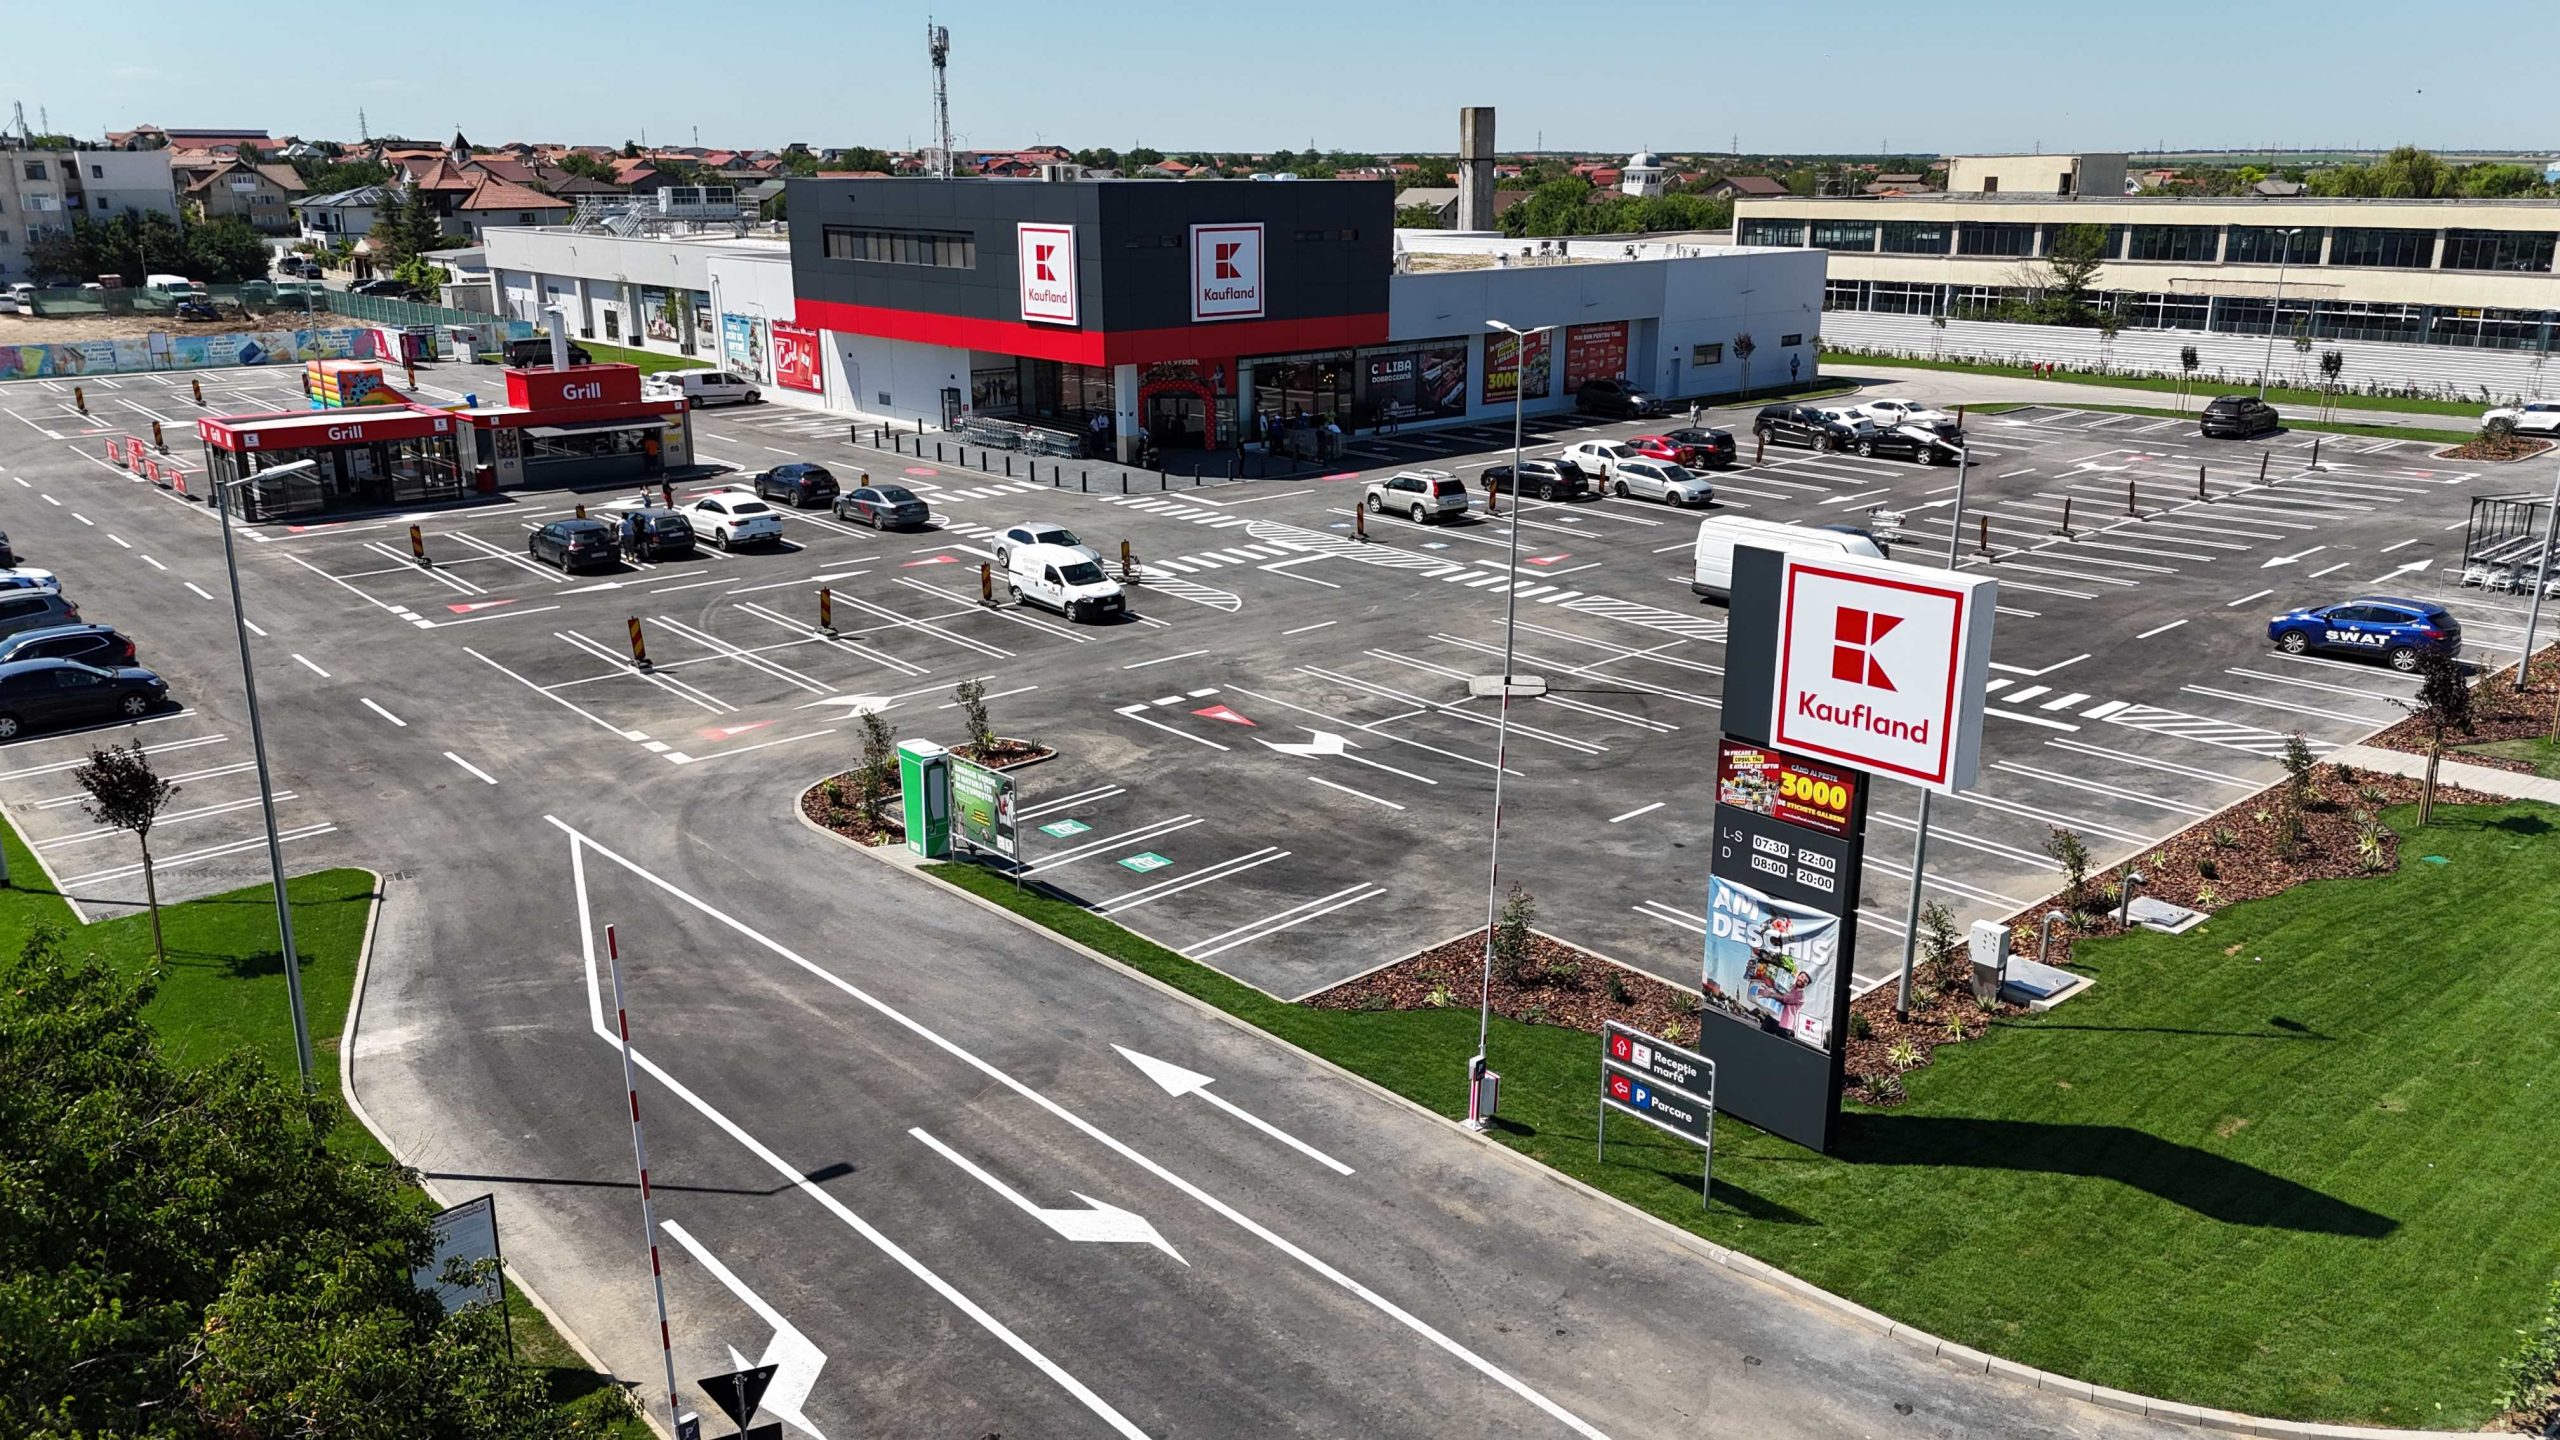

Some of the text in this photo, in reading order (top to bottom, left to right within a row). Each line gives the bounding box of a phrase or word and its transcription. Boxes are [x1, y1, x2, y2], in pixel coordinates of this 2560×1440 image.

[1028, 288, 1068, 304] Kaufland
[1203, 286, 1255, 302] Kaufland
[563, 382, 601, 400] Grill
[328, 425, 363, 440] Grill
[2325, 630, 2390, 646] SWAT
[1798, 691, 1929, 745] Kaufland
[1779, 771, 1847, 811] 3000
[1777, 799, 1786, 808] DE
[1723, 826, 1743, 843] L-S
[1722, 846, 1731, 858] D
[1754, 837, 1788, 855] 07:30
[1800, 850, 1834, 870] 22:00
[1753, 856, 1786, 875] 08:00
[1798, 870, 1833, 890] 20:00
[1713, 886, 1760, 921] AM
[1712, 911, 1830, 966] DESCHIS
[1654, 1050, 1697, 1077] Recepție
[1653, 1065, 1685, 1084] marfă
[1636, 1088, 1693, 1123] P Parcare
